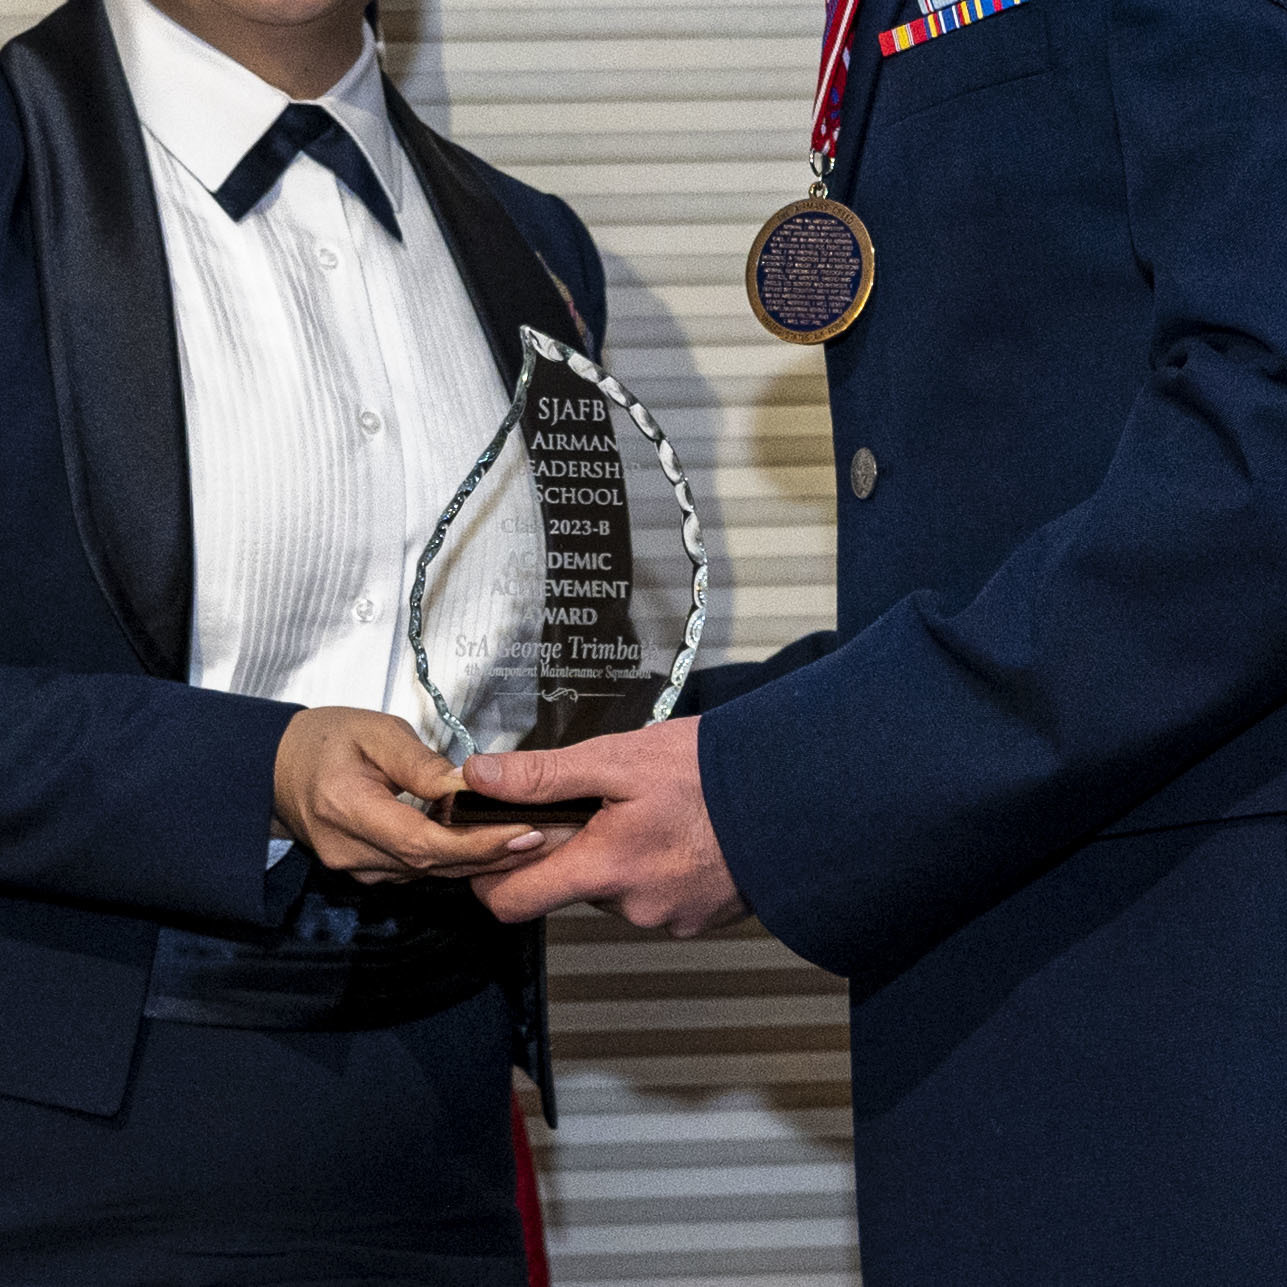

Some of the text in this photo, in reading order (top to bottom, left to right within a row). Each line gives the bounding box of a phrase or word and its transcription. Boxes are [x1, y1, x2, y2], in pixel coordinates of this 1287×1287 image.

[537, 397, 606, 426] SJAFB
[530, 430, 619, 452] AIRMAN
[534, 484, 623, 506] SCHOOL
[549, 519, 611, 536] 2023-B
[507, 550, 613, 571] ACDEMIC
[522, 606, 599, 626] AWARD
[455, 633, 489, 658] SrA
[497, 635, 562, 664] George
[483, 665, 537, 680] omponent
[540, 663, 604, 679] Maintenance
